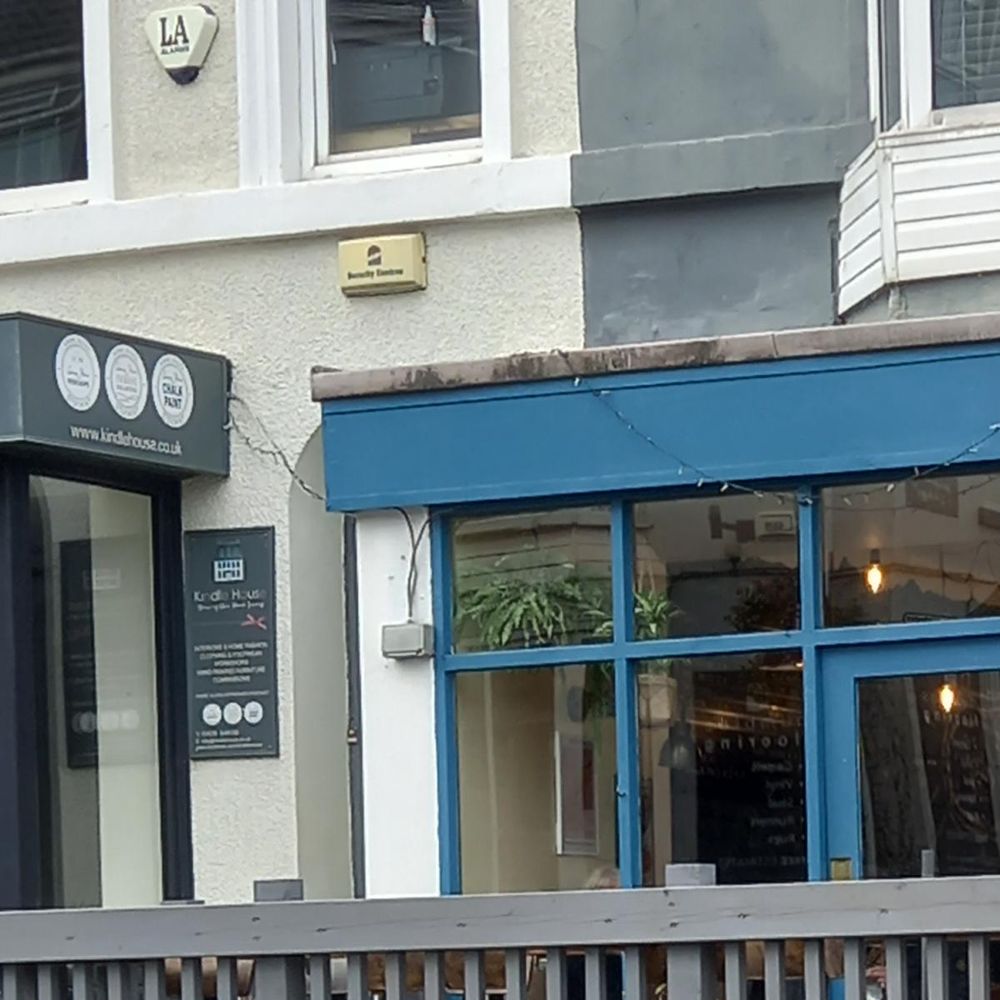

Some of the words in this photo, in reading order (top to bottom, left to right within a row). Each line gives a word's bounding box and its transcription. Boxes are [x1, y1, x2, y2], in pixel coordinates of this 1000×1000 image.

[159, 14, 190, 47] LA
[162, 382, 183, 396] CHALK
[163, 395, 183, 409] PAINT
